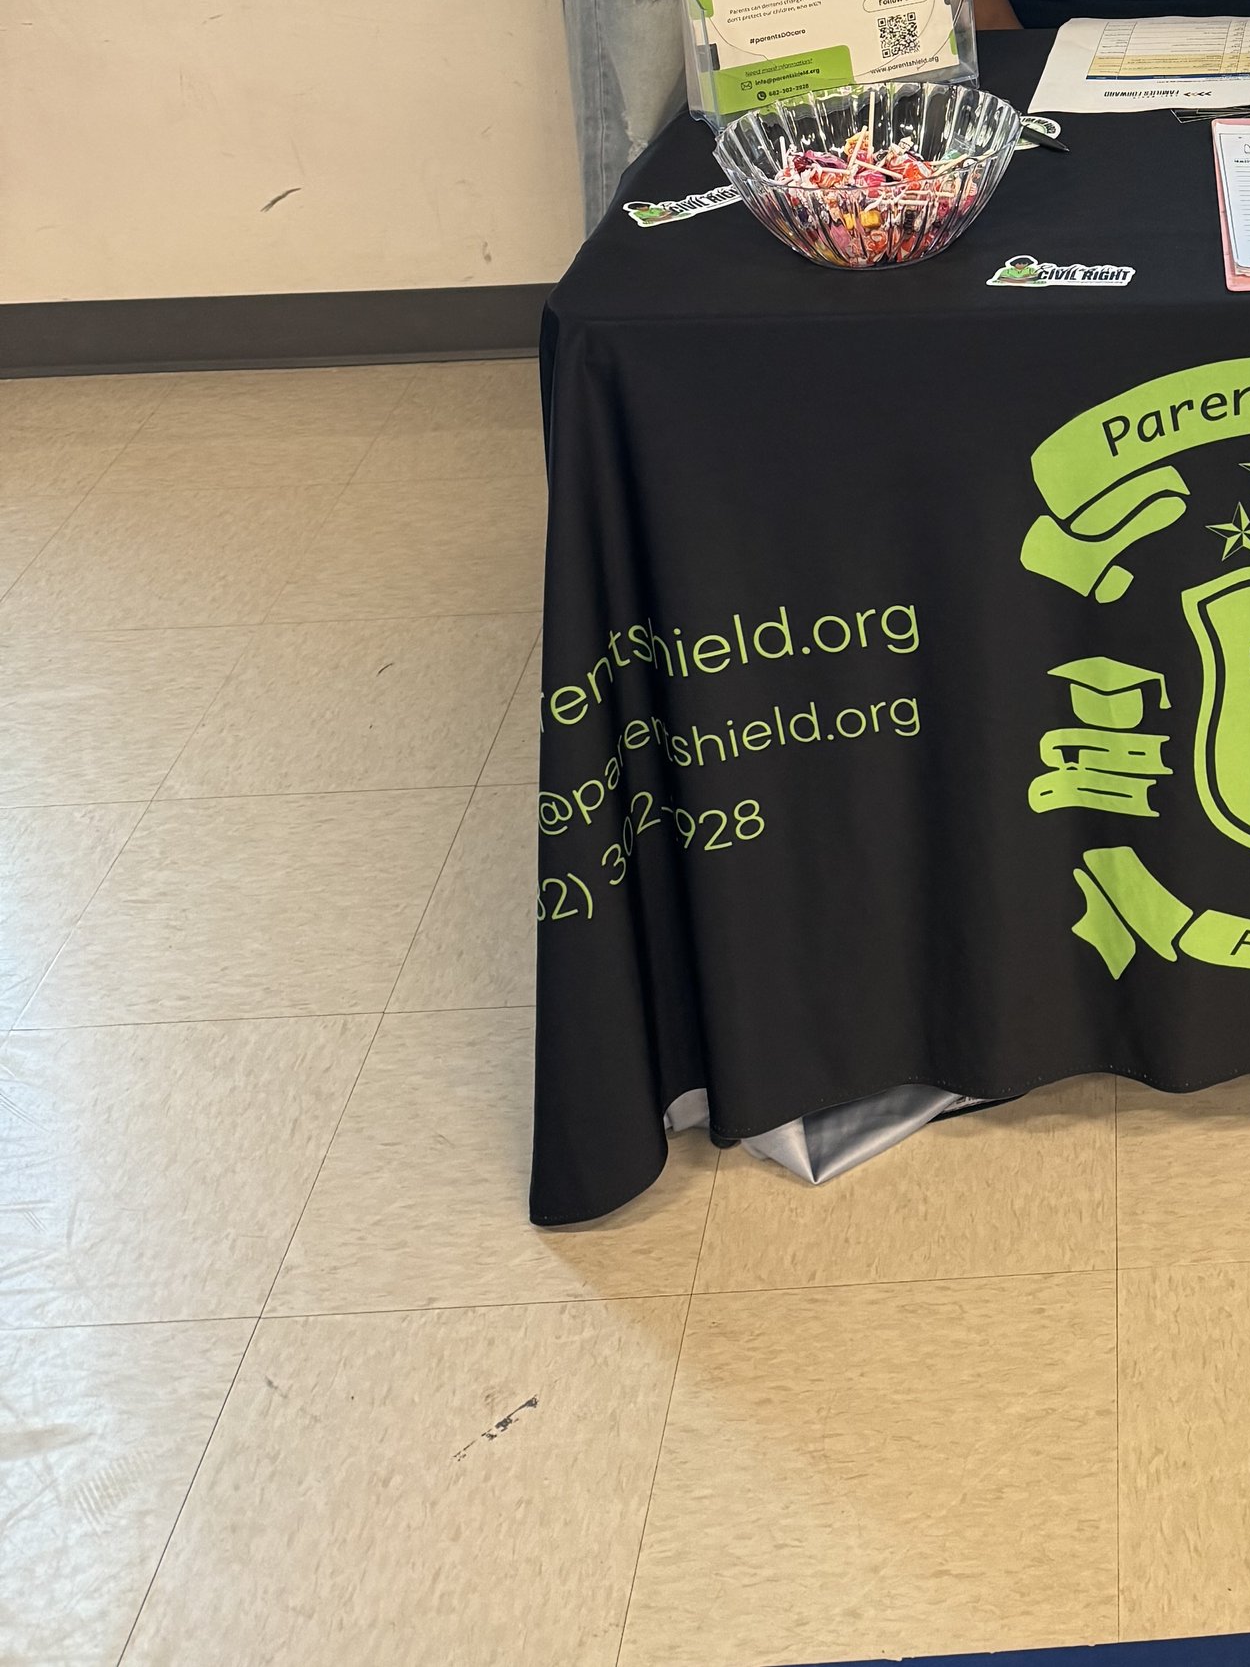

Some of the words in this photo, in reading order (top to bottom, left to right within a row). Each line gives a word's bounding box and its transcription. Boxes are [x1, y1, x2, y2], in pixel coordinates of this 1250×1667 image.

[870, 56, 939, 74] www.parentshield.org
[669, 196, 710, 213] CIVIL
[1039, 268, 1077, 280] CIVIL
[1082, 269, 1130, 280] RIGHT
[601, 791, 765, 887] 302-928
